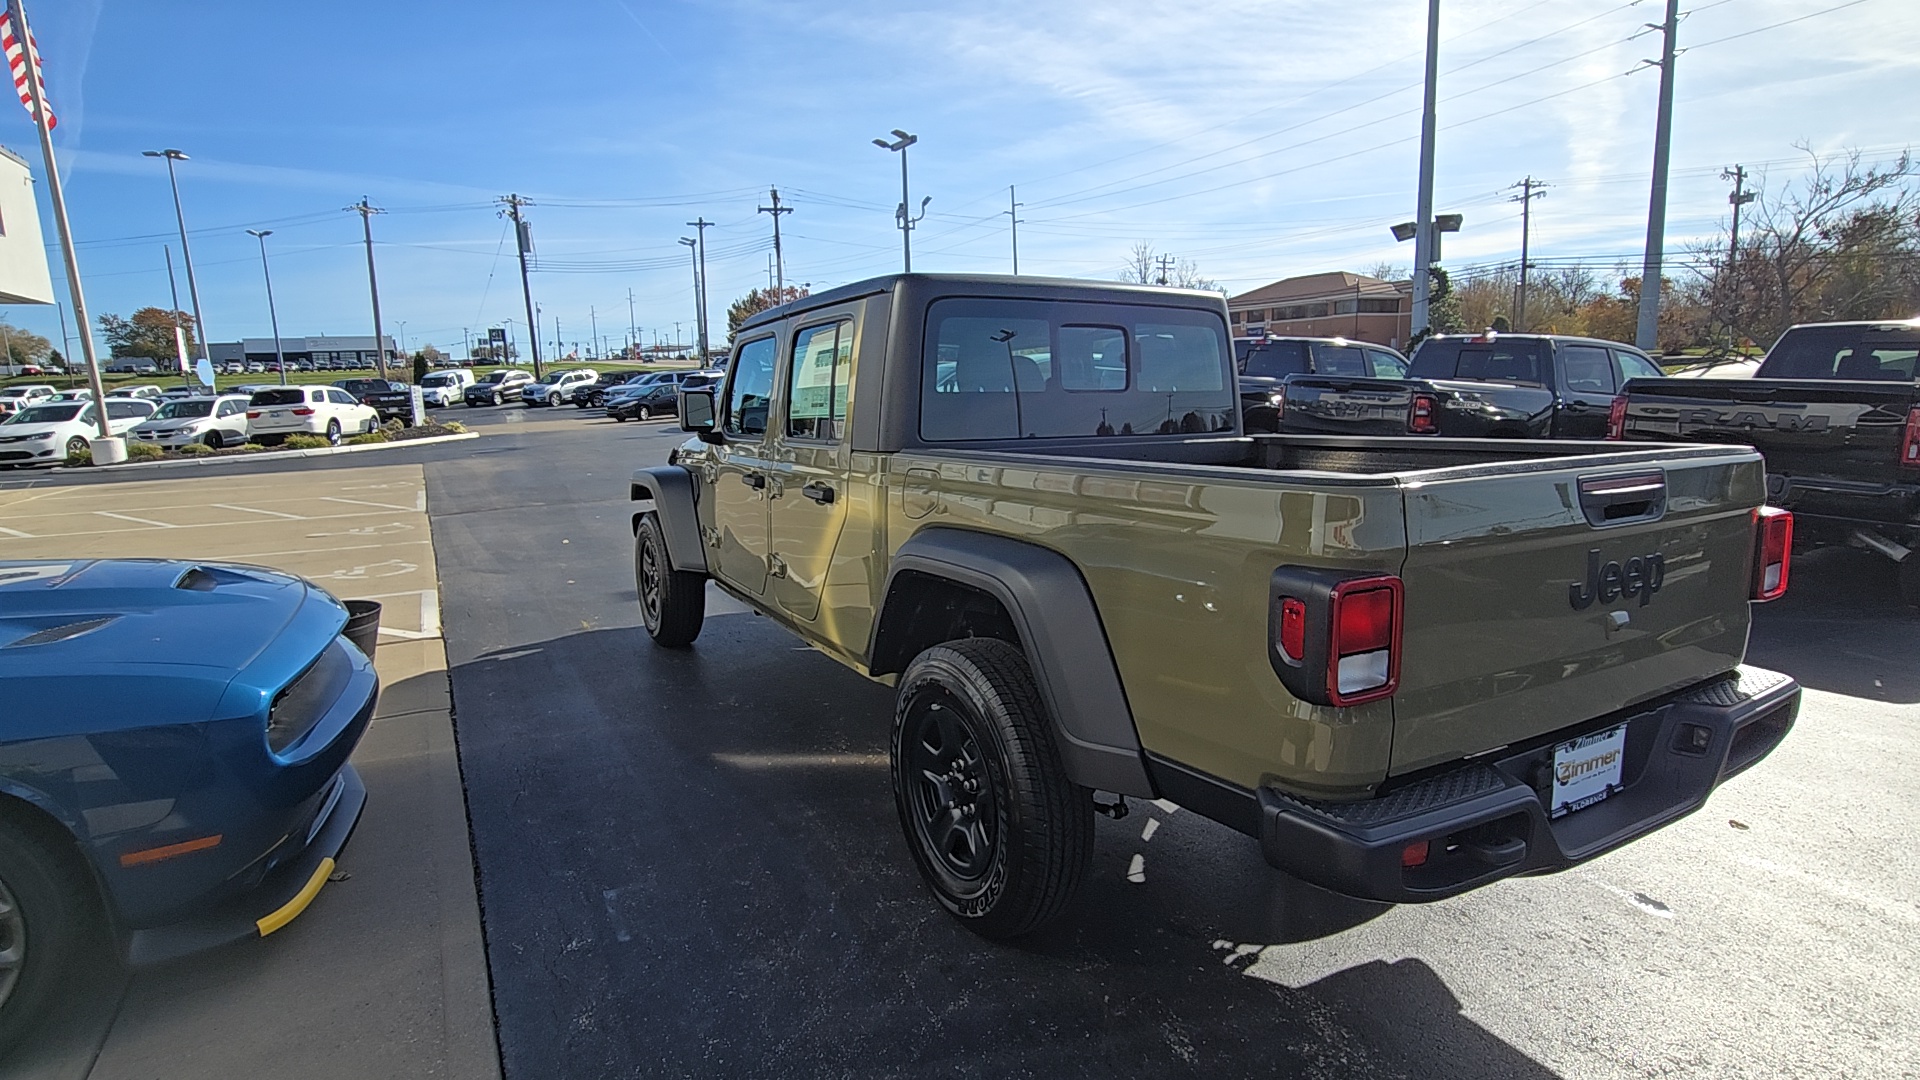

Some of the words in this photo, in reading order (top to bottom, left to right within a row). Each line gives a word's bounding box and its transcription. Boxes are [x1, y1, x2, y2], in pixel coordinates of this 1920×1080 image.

[1678, 409, 1831, 431] RAM
[1569, 548, 1665, 611] Jeep
[1559, 749, 1620, 782] Zimmer
[1571, 791, 1608, 812] FLORENCE
